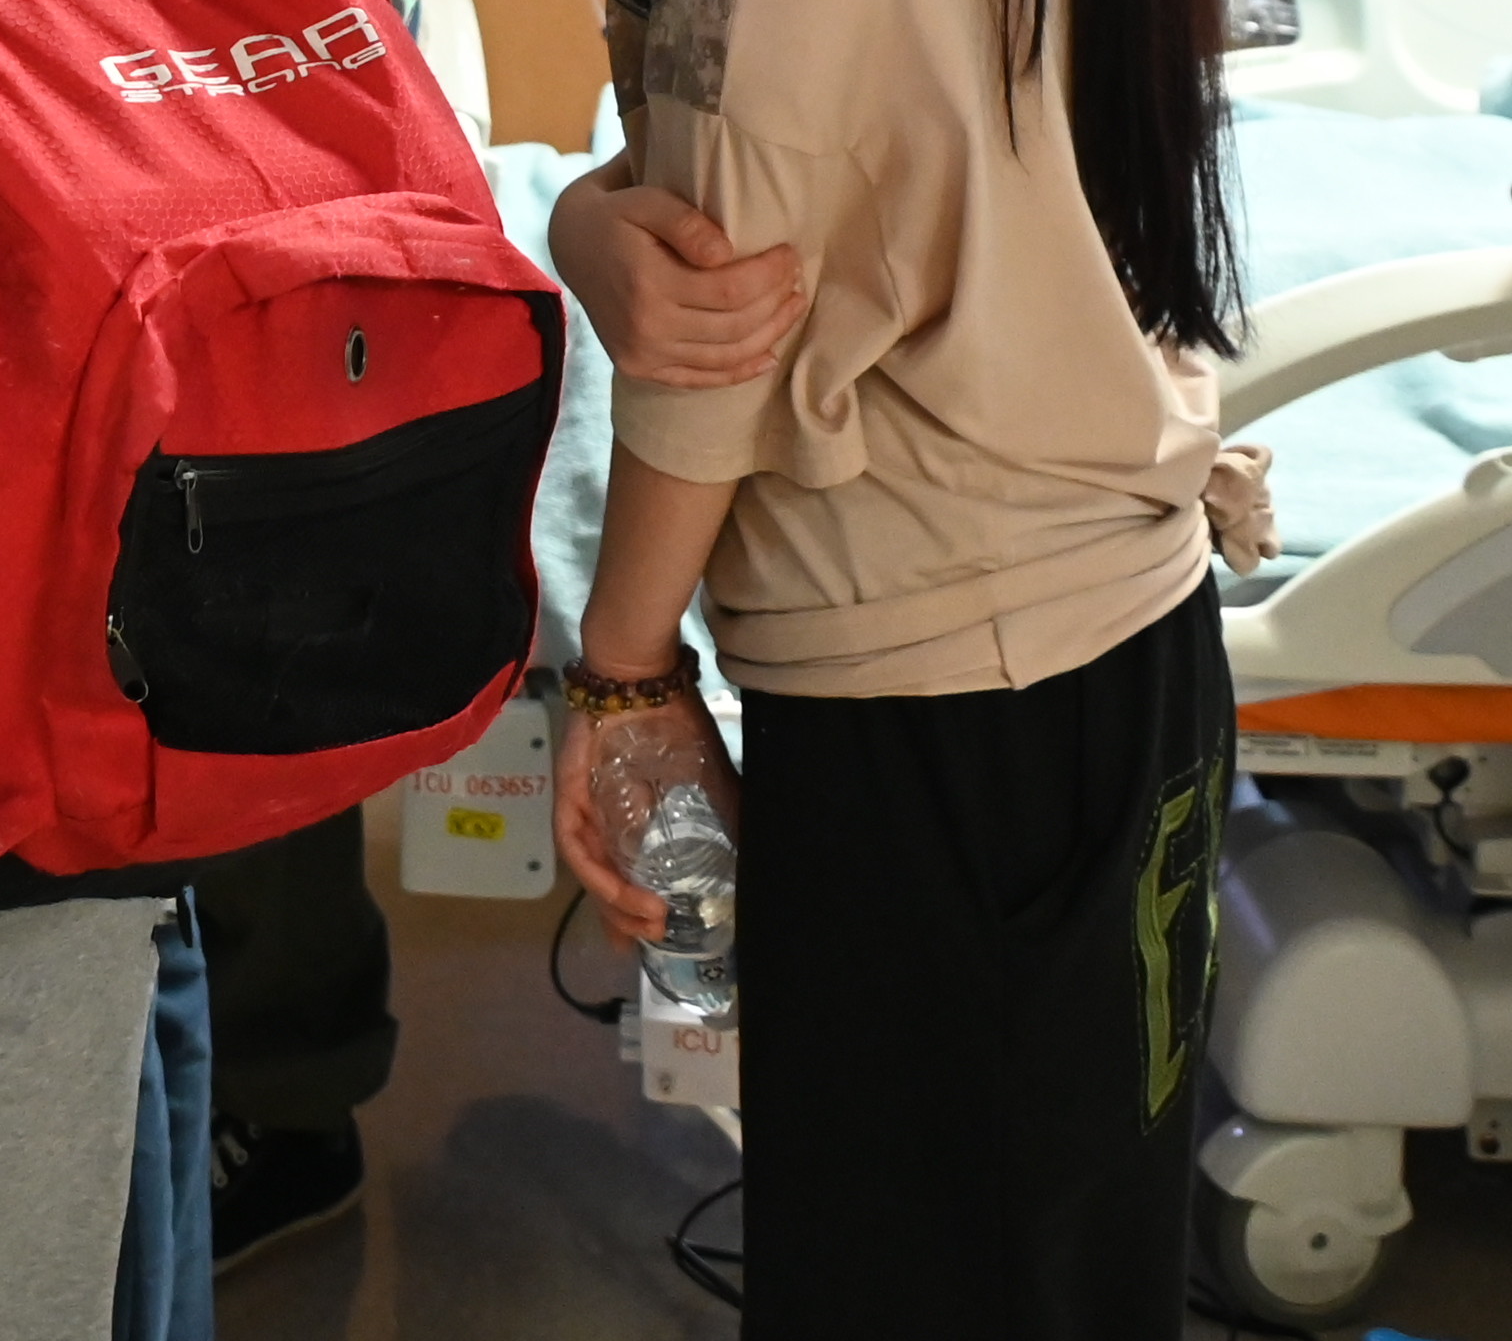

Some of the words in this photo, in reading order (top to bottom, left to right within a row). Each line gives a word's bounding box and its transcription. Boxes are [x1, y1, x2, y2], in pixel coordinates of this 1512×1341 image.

[98, 6, 380, 89] GEAR
[412, 771, 453, 794] ICU
[466, 773, 547, 798] 063657
[673, 1028, 723, 1057] ICU
